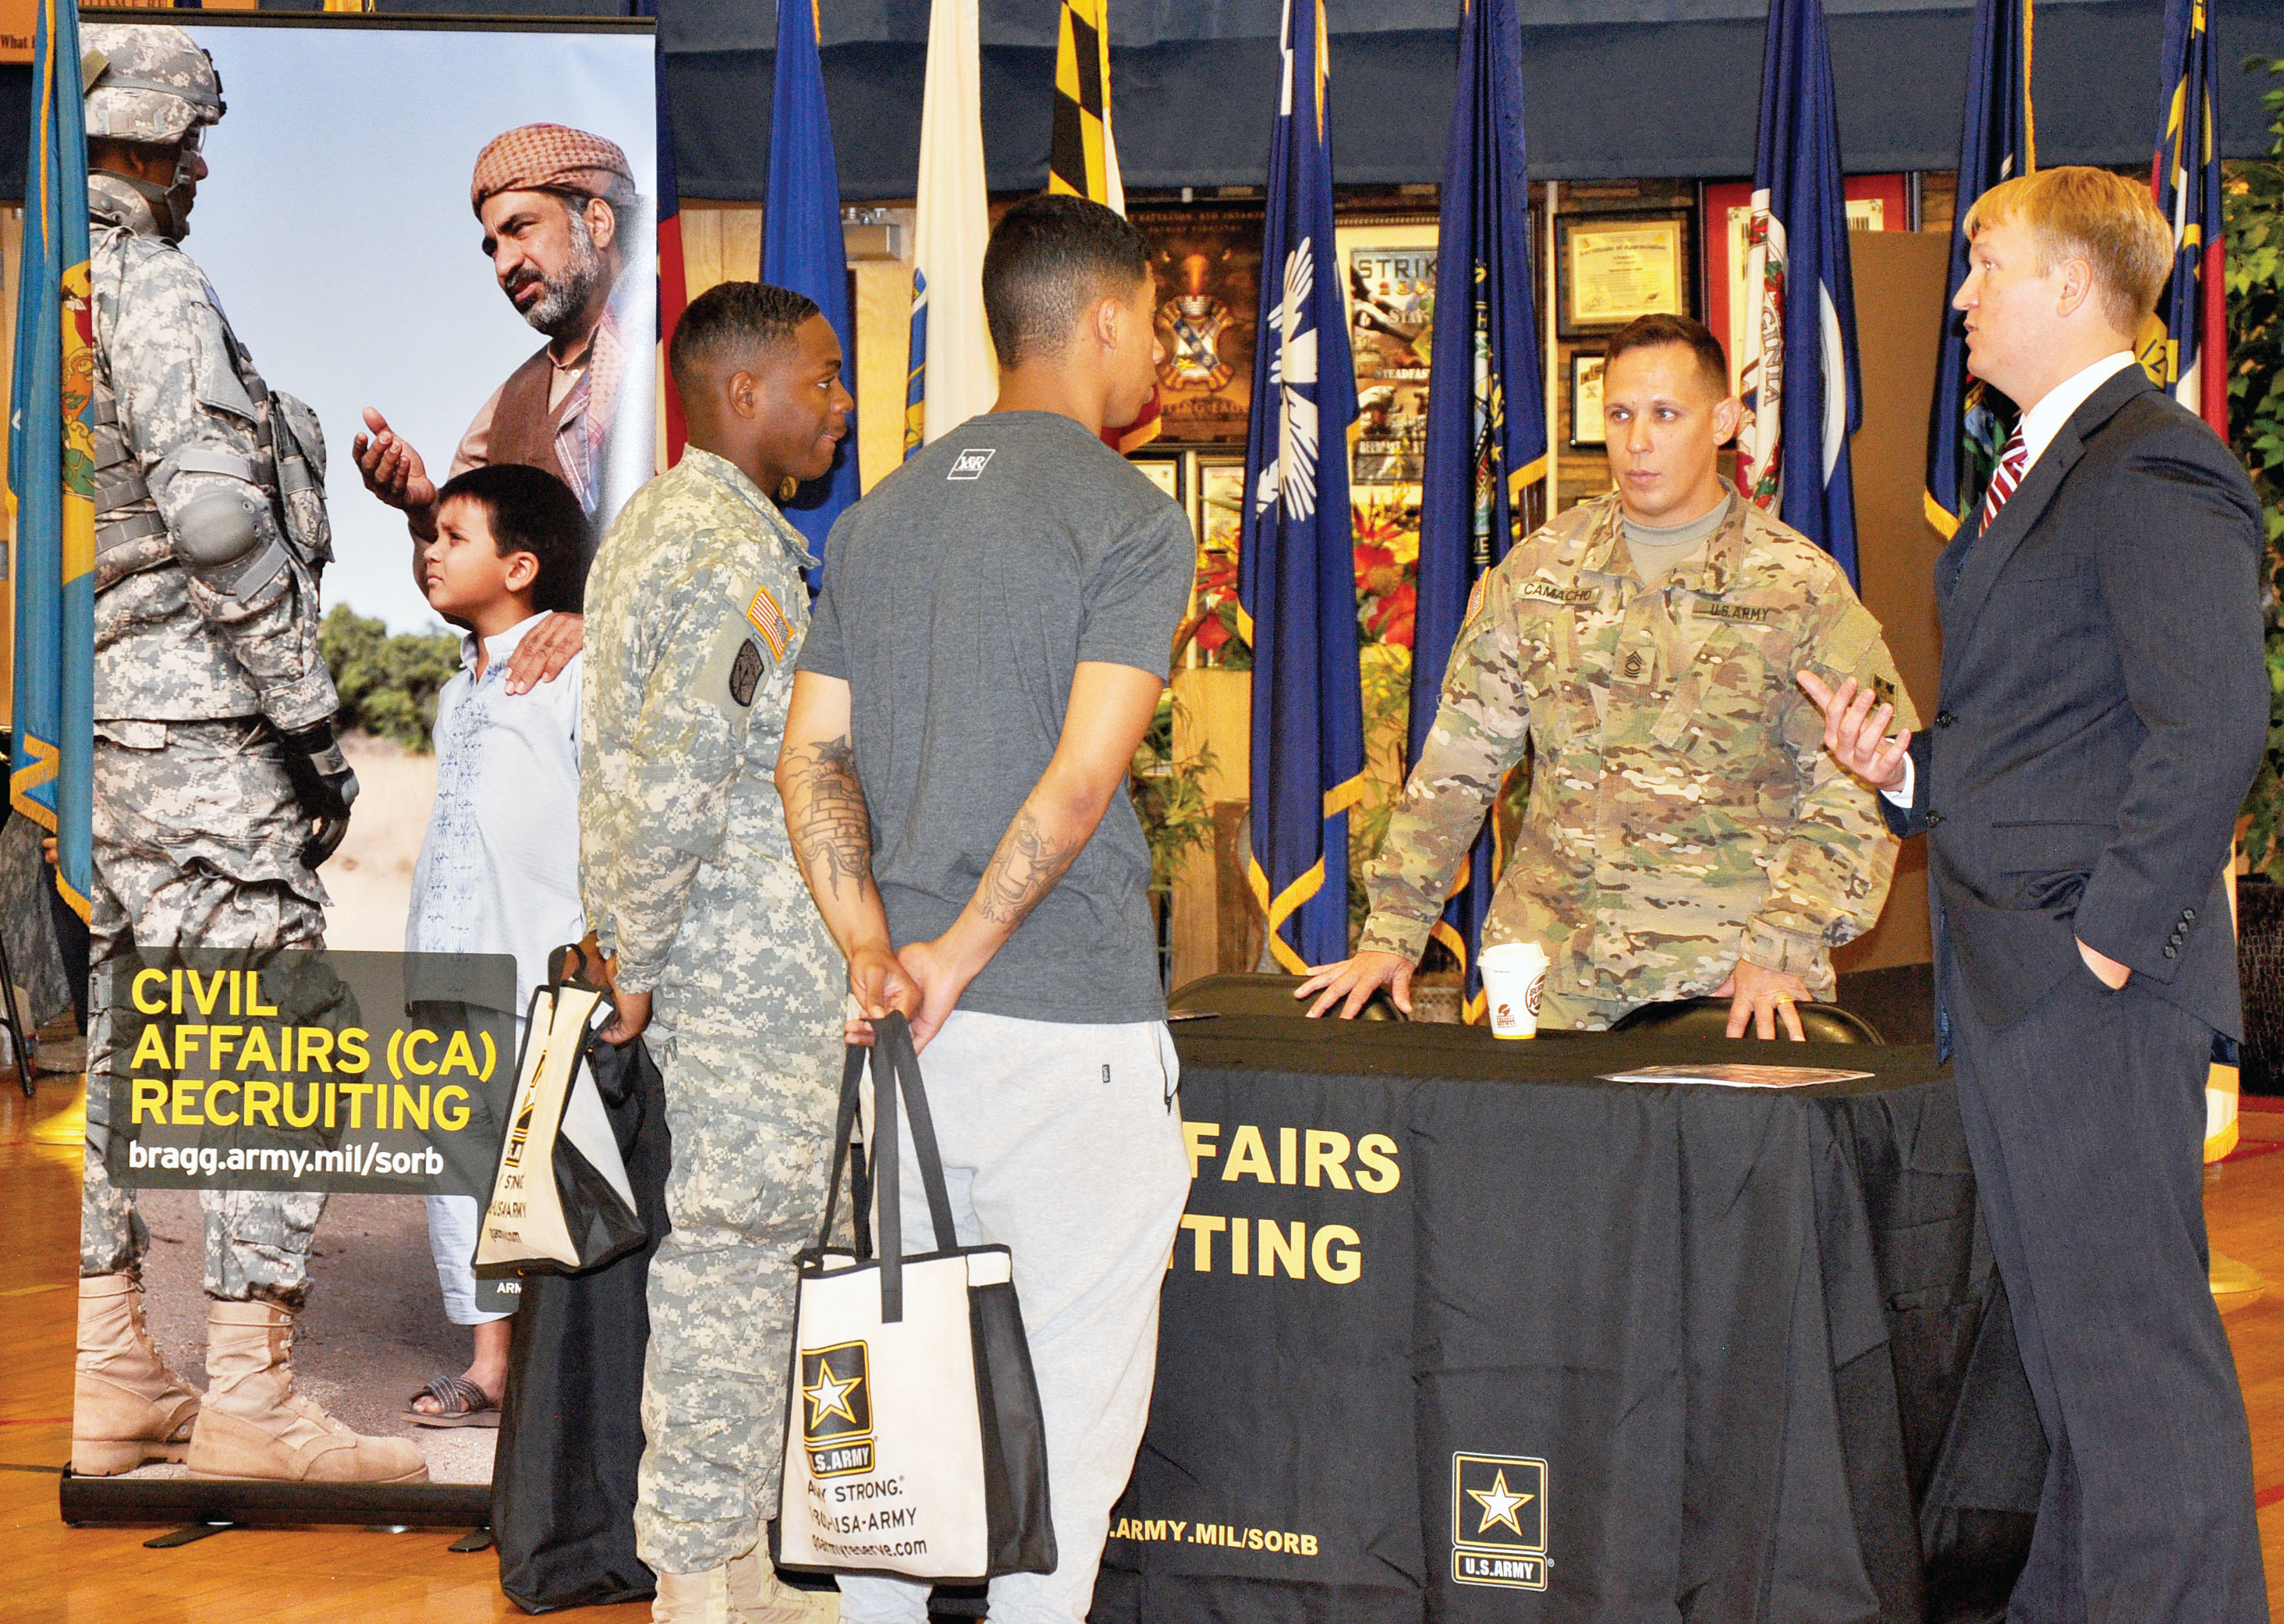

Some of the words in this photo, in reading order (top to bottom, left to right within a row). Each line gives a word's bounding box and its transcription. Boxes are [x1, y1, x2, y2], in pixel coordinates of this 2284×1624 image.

[1523, 583, 1592, 601] CAMACHO
[131, 967, 278, 1017] CIVIL
[129, 1023, 371, 1074] AFFAIRS
[386, 1028, 498, 1083] (CA)
[130, 1079, 471, 1132] RECRUITING
[129, 1140, 445, 1178] bragg.army.mil/sorb
[1167, 1213, 1362, 1285] TING
